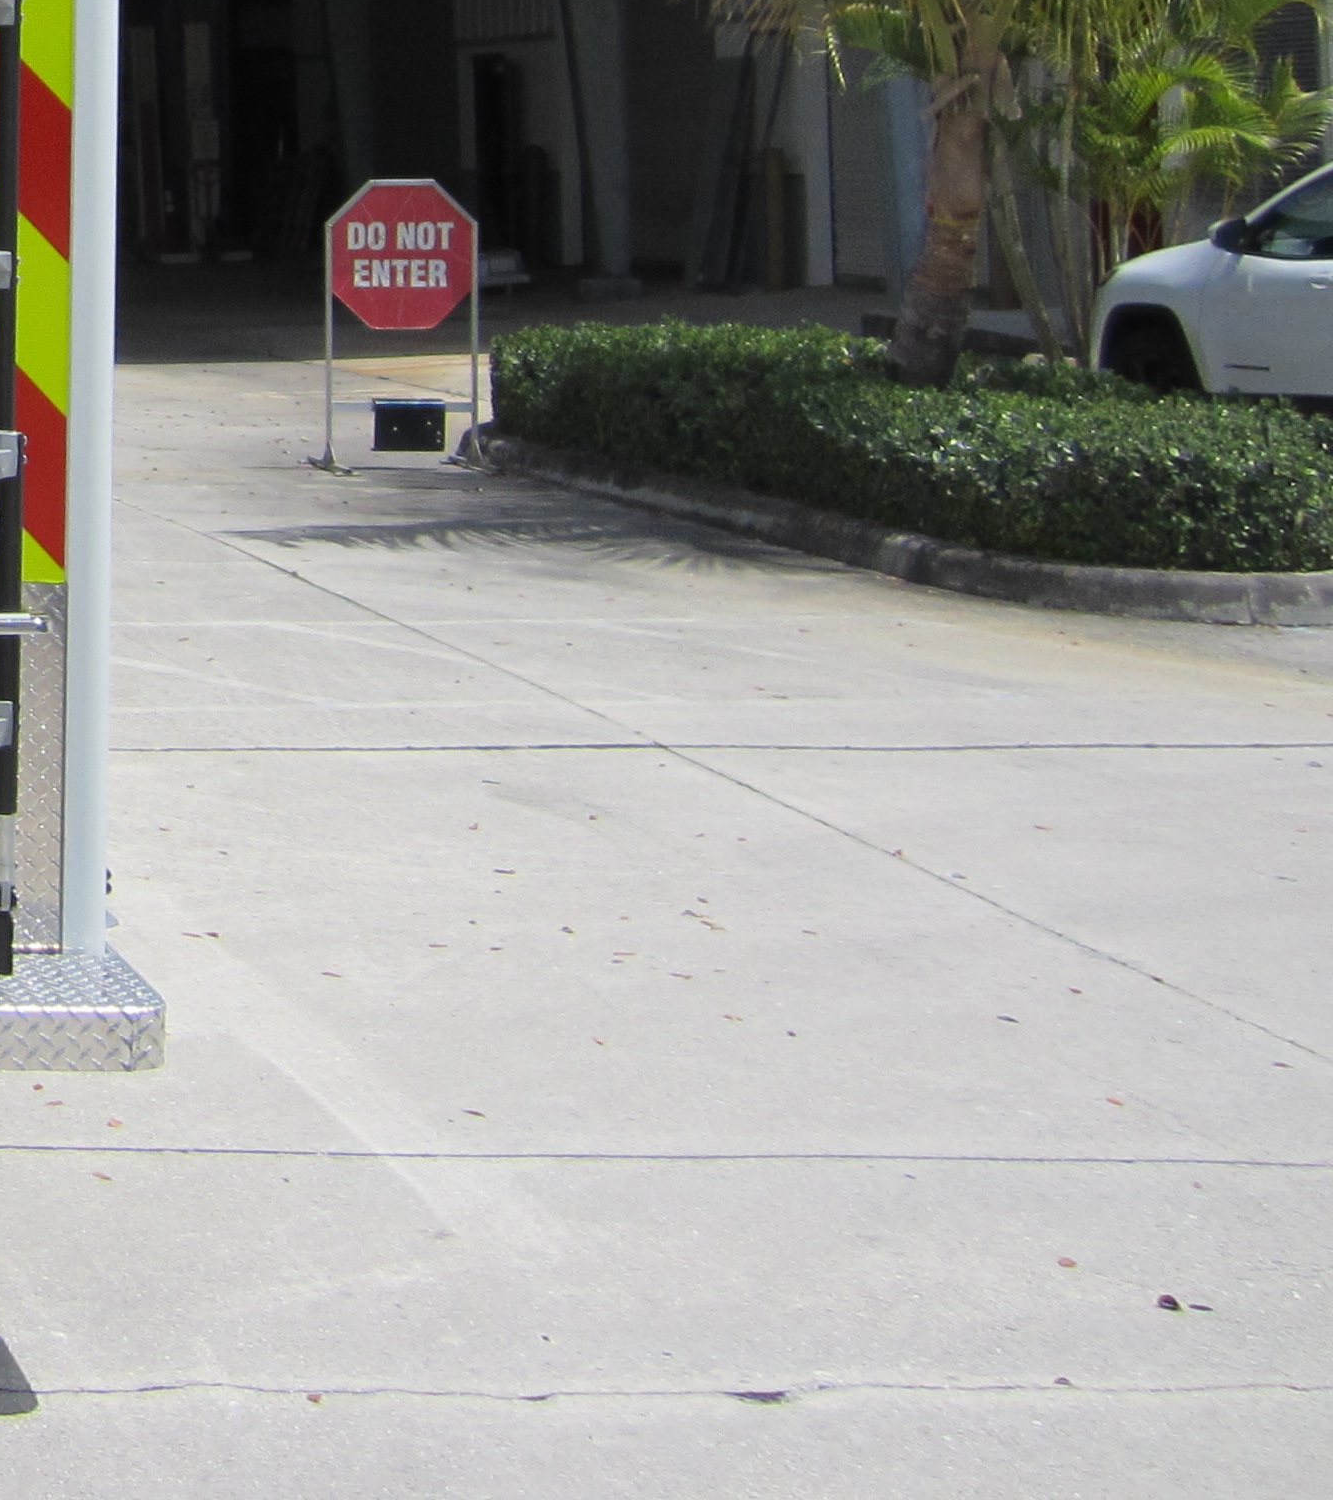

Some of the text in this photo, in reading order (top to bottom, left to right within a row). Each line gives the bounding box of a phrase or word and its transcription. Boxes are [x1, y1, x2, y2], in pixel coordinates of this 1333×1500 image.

[347, 221, 455, 250] DO NOT
[353, 258, 448, 287] ENTER
